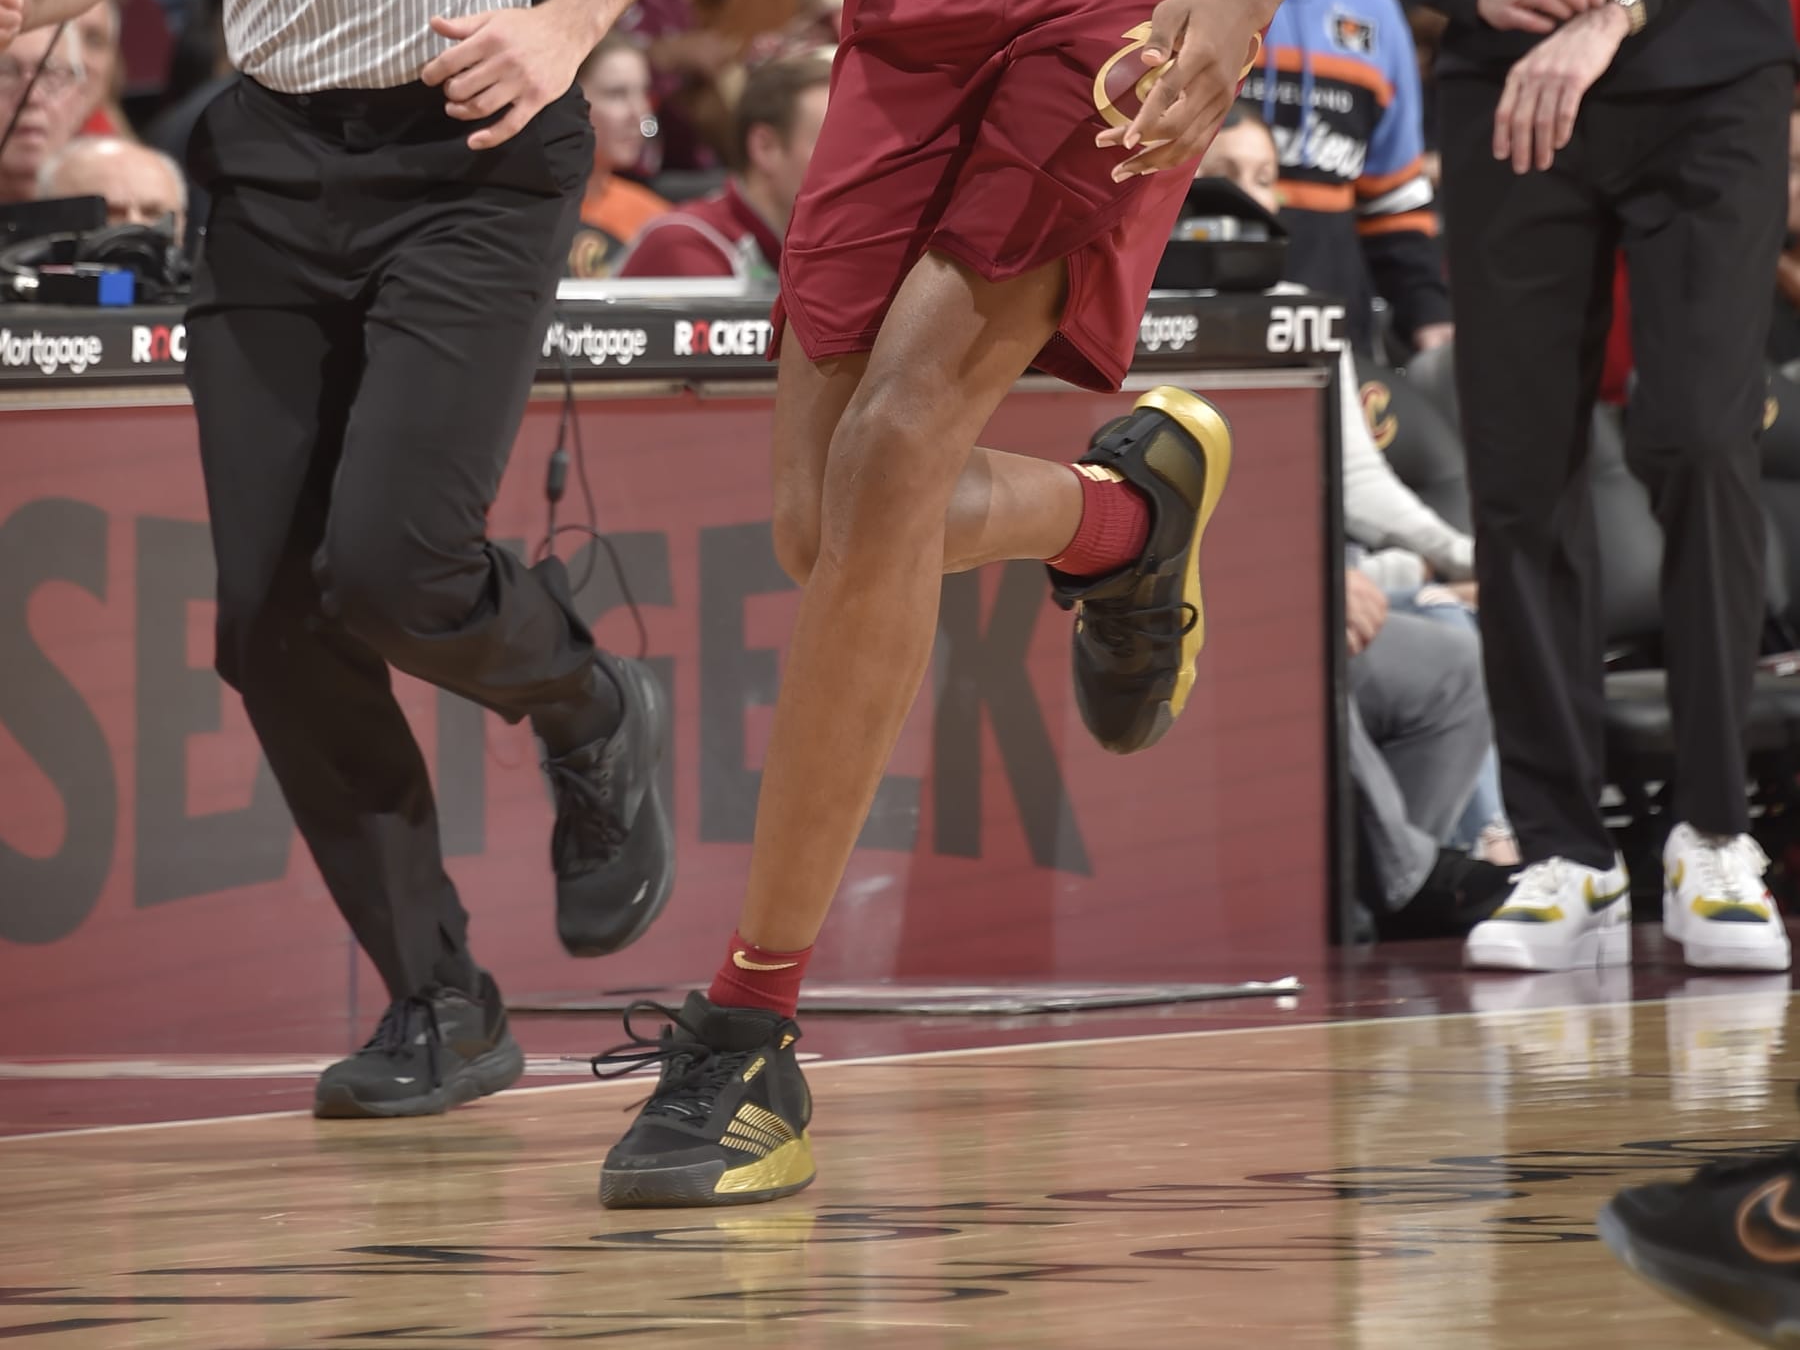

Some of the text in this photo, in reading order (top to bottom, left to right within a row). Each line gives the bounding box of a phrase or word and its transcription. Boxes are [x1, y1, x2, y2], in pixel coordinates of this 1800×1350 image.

[131, 323, 188, 363] ROC
[542, 321, 648, 366] Mortgage
[1266, 305, 1346, 353] anc
